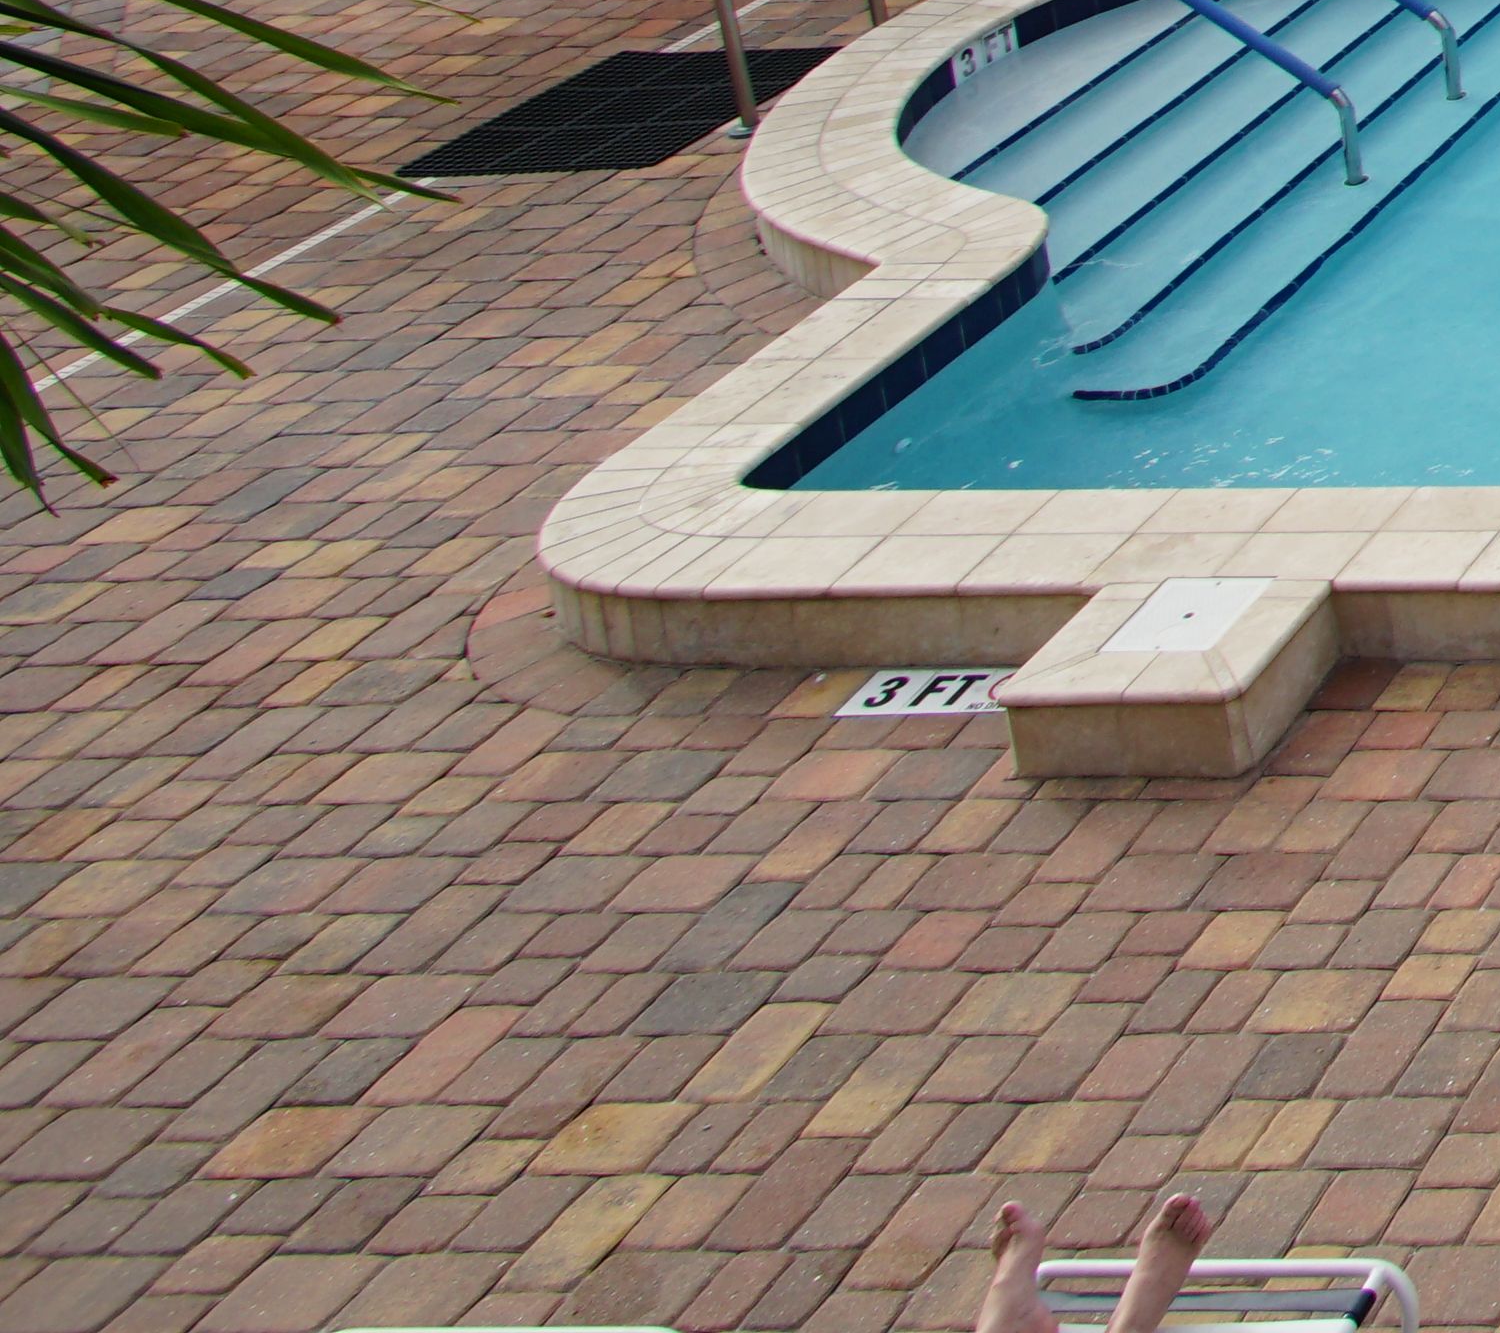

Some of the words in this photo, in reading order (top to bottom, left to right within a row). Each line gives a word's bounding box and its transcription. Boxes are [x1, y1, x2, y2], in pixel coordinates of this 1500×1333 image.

[961, 48, 977, 77] 3
[983, 23, 1013, 64] FT
[864, 676, 911, 708] 3
[908, 674, 990, 707] FT
[965, 702, 984, 710] NO
